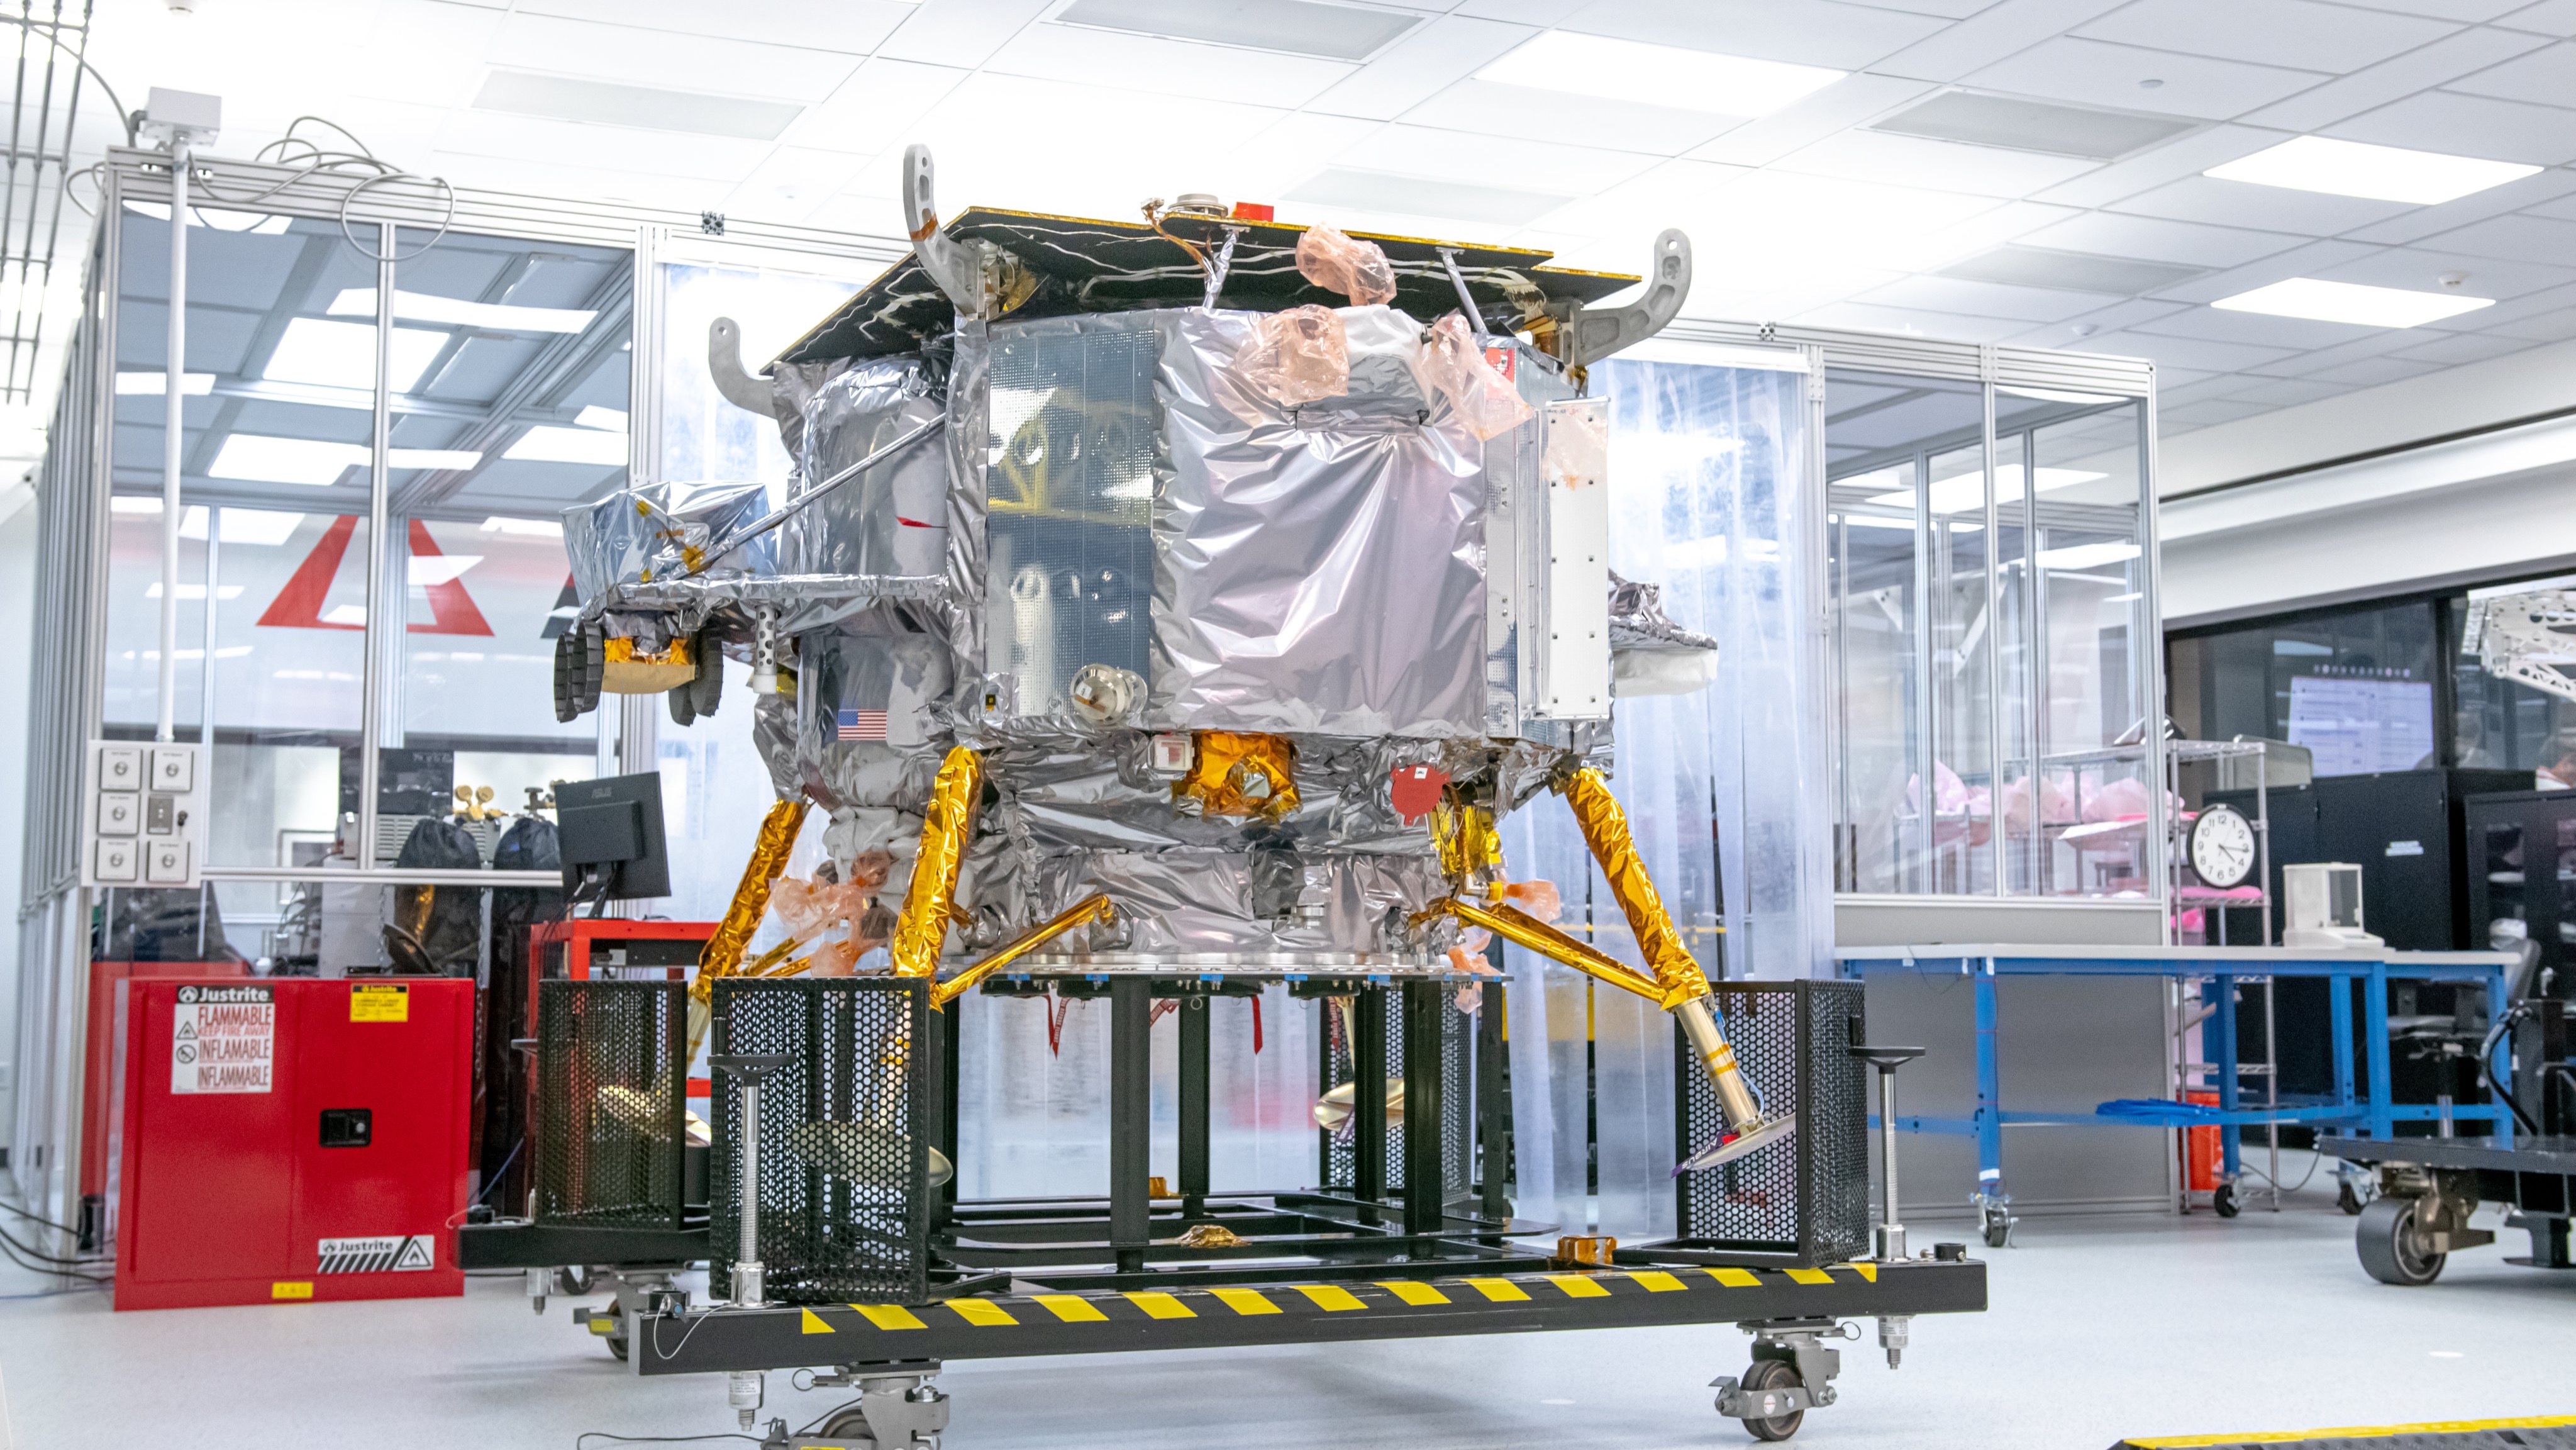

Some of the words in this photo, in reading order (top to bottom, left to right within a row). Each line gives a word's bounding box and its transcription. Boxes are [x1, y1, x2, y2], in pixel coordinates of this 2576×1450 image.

[2209, 819, 2214, 827] 11
[2218, 815, 2227, 824] 12
[2233, 820, 2236, 828] 1
[2202, 828, 2210, 837] 10
[2238, 829, 2245, 839] 2
[2198, 840, 2204, 850] 9
[2201, 856, 2206, 865] 8
[2238, 858, 2245, 867] 4
[2208, 866, 2213, 874] 7
[2218, 869, 2224, 880] 6
[2229, 866, 2236, 877] 5
[199, 986, 269, 1002] Justrite
[198, 1006, 271, 1025] FLAMMABLE
[198, 1026, 219, 1037] KEEP
[221, 1025, 242, 1036] FIRE
[244, 1025, 270, 1035] AWAY
[199, 1039, 269, 1059] INFLAMABLE
[197, 1066, 269, 1086] INFLAMMABLE
[1682, 1137, 1718, 1169] AIRBUS
[339, 1240, 393, 1251] Justrite
